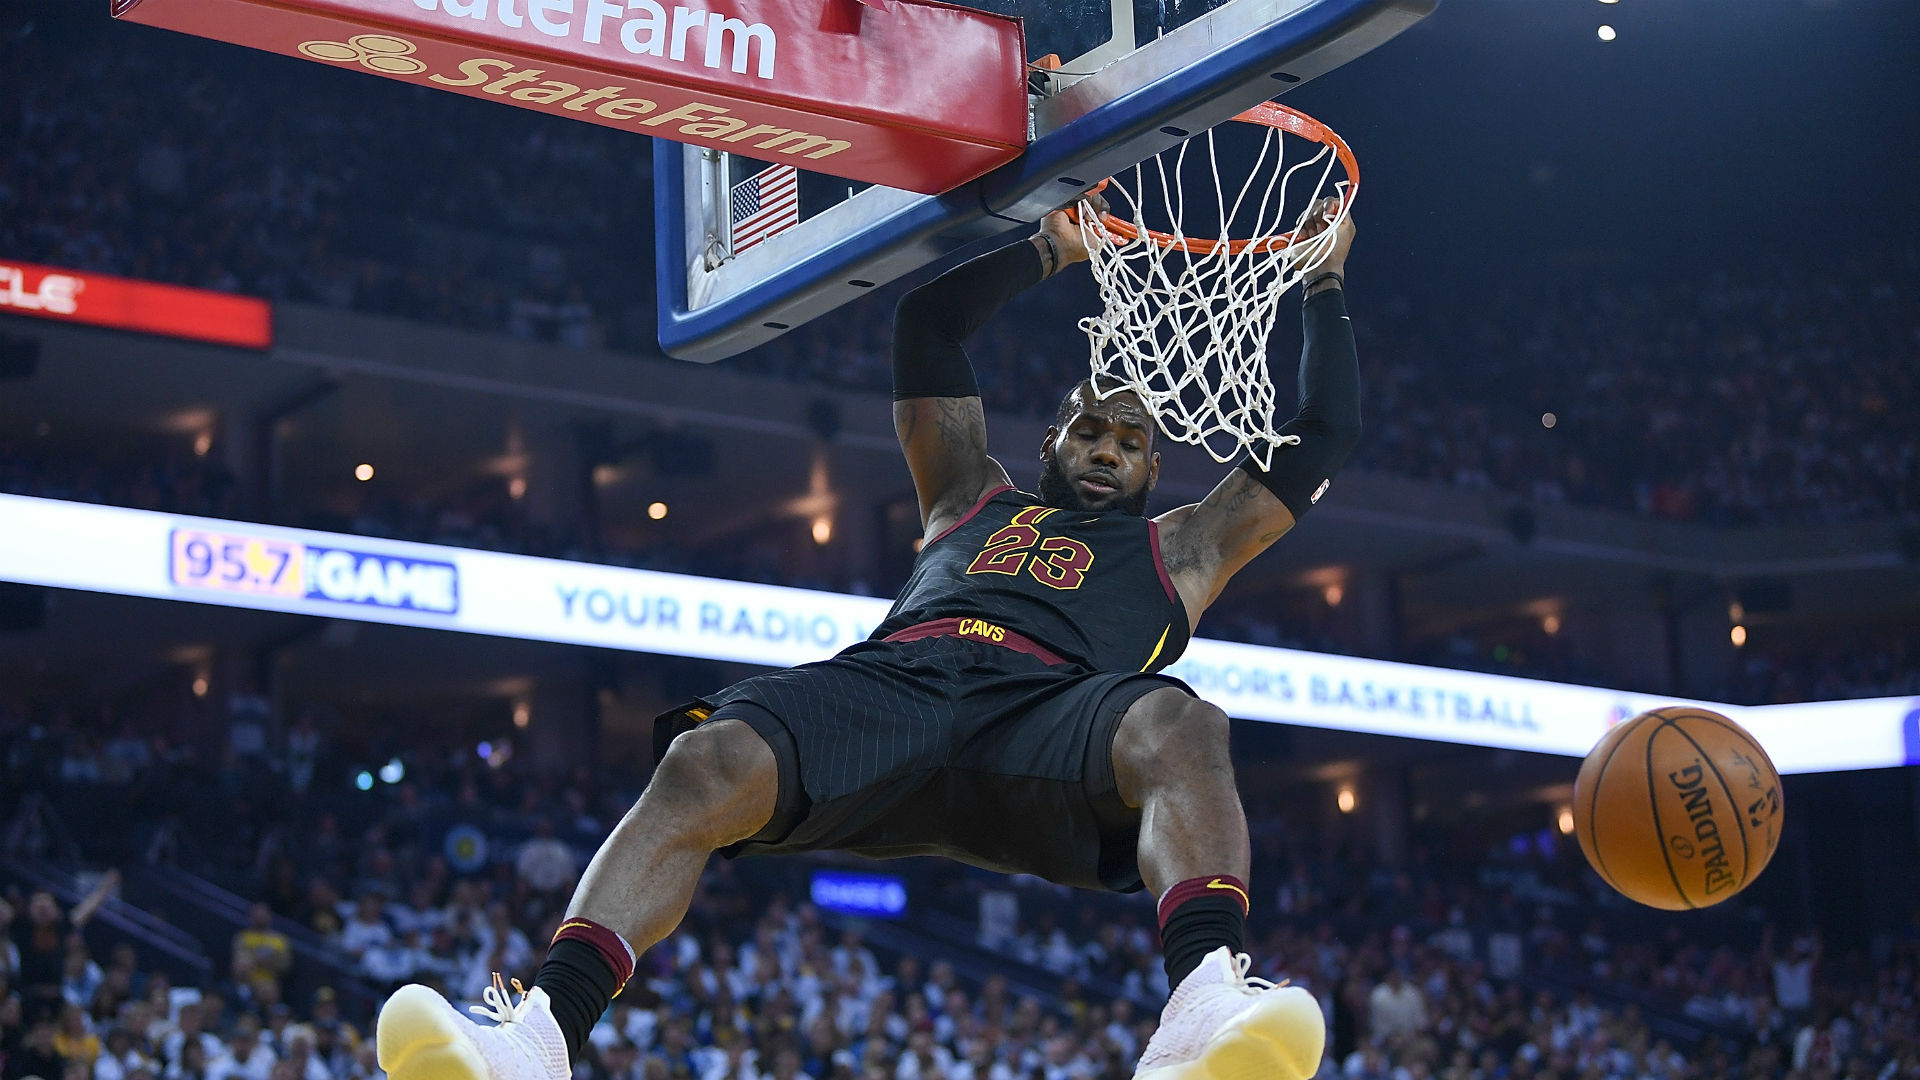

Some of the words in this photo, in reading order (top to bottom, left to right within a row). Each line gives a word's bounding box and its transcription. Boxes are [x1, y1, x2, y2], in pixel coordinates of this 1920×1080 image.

[185, 539, 290, 586] 95.7
[317, 549, 457, 611] GAME
[965, 524, 1095, 590] 23
[555, 582, 683, 633] YOUR
[697, 600, 841, 650] RADIO
[958, 618, 1006, 642] CAVS
[1308, 672, 1543, 735] BASKETBALL
